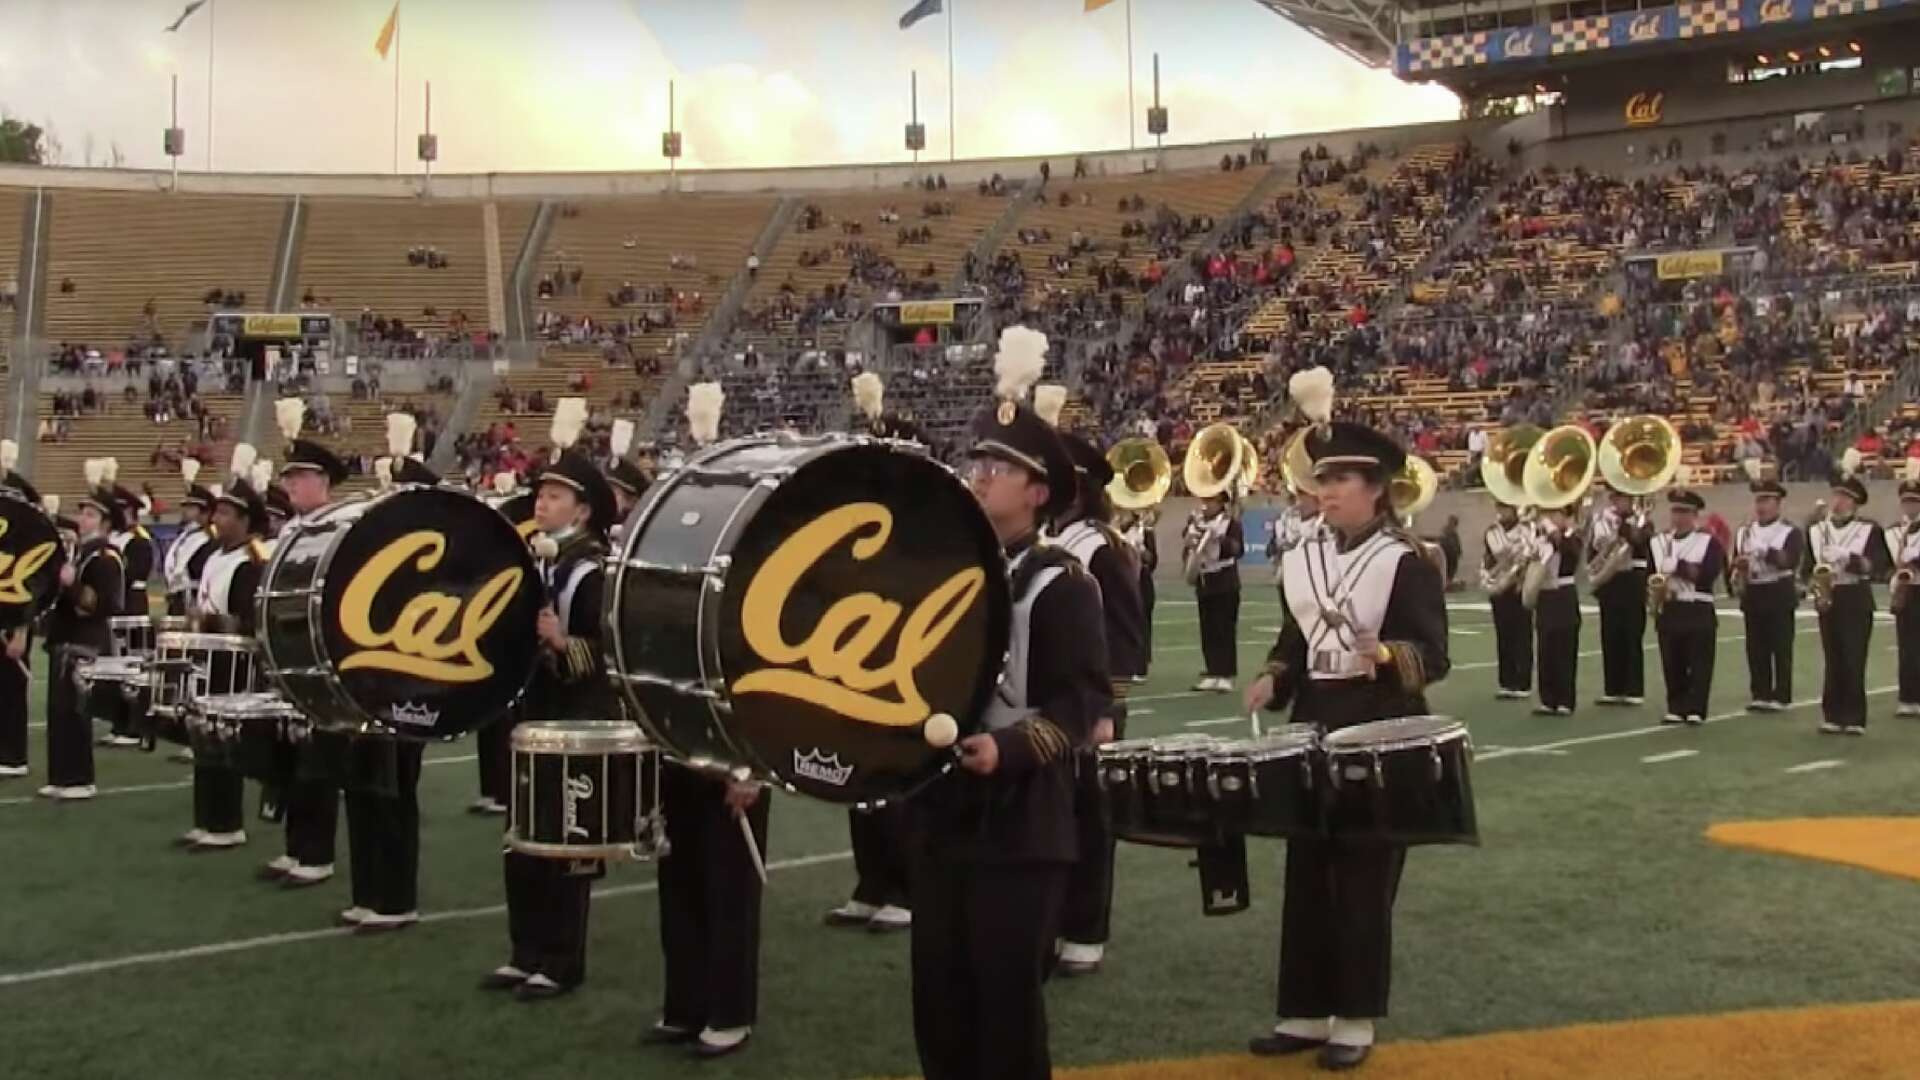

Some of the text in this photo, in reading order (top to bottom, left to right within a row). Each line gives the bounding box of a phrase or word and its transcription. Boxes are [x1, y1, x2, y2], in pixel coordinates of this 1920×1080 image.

[1629, 14, 1660, 41] Cal
[1504, 31, 1533, 58] Cal
[1625, 92, 1663, 125] Cal
[339, 530, 524, 682] Cal
[731, 501, 985, 727] Cal
